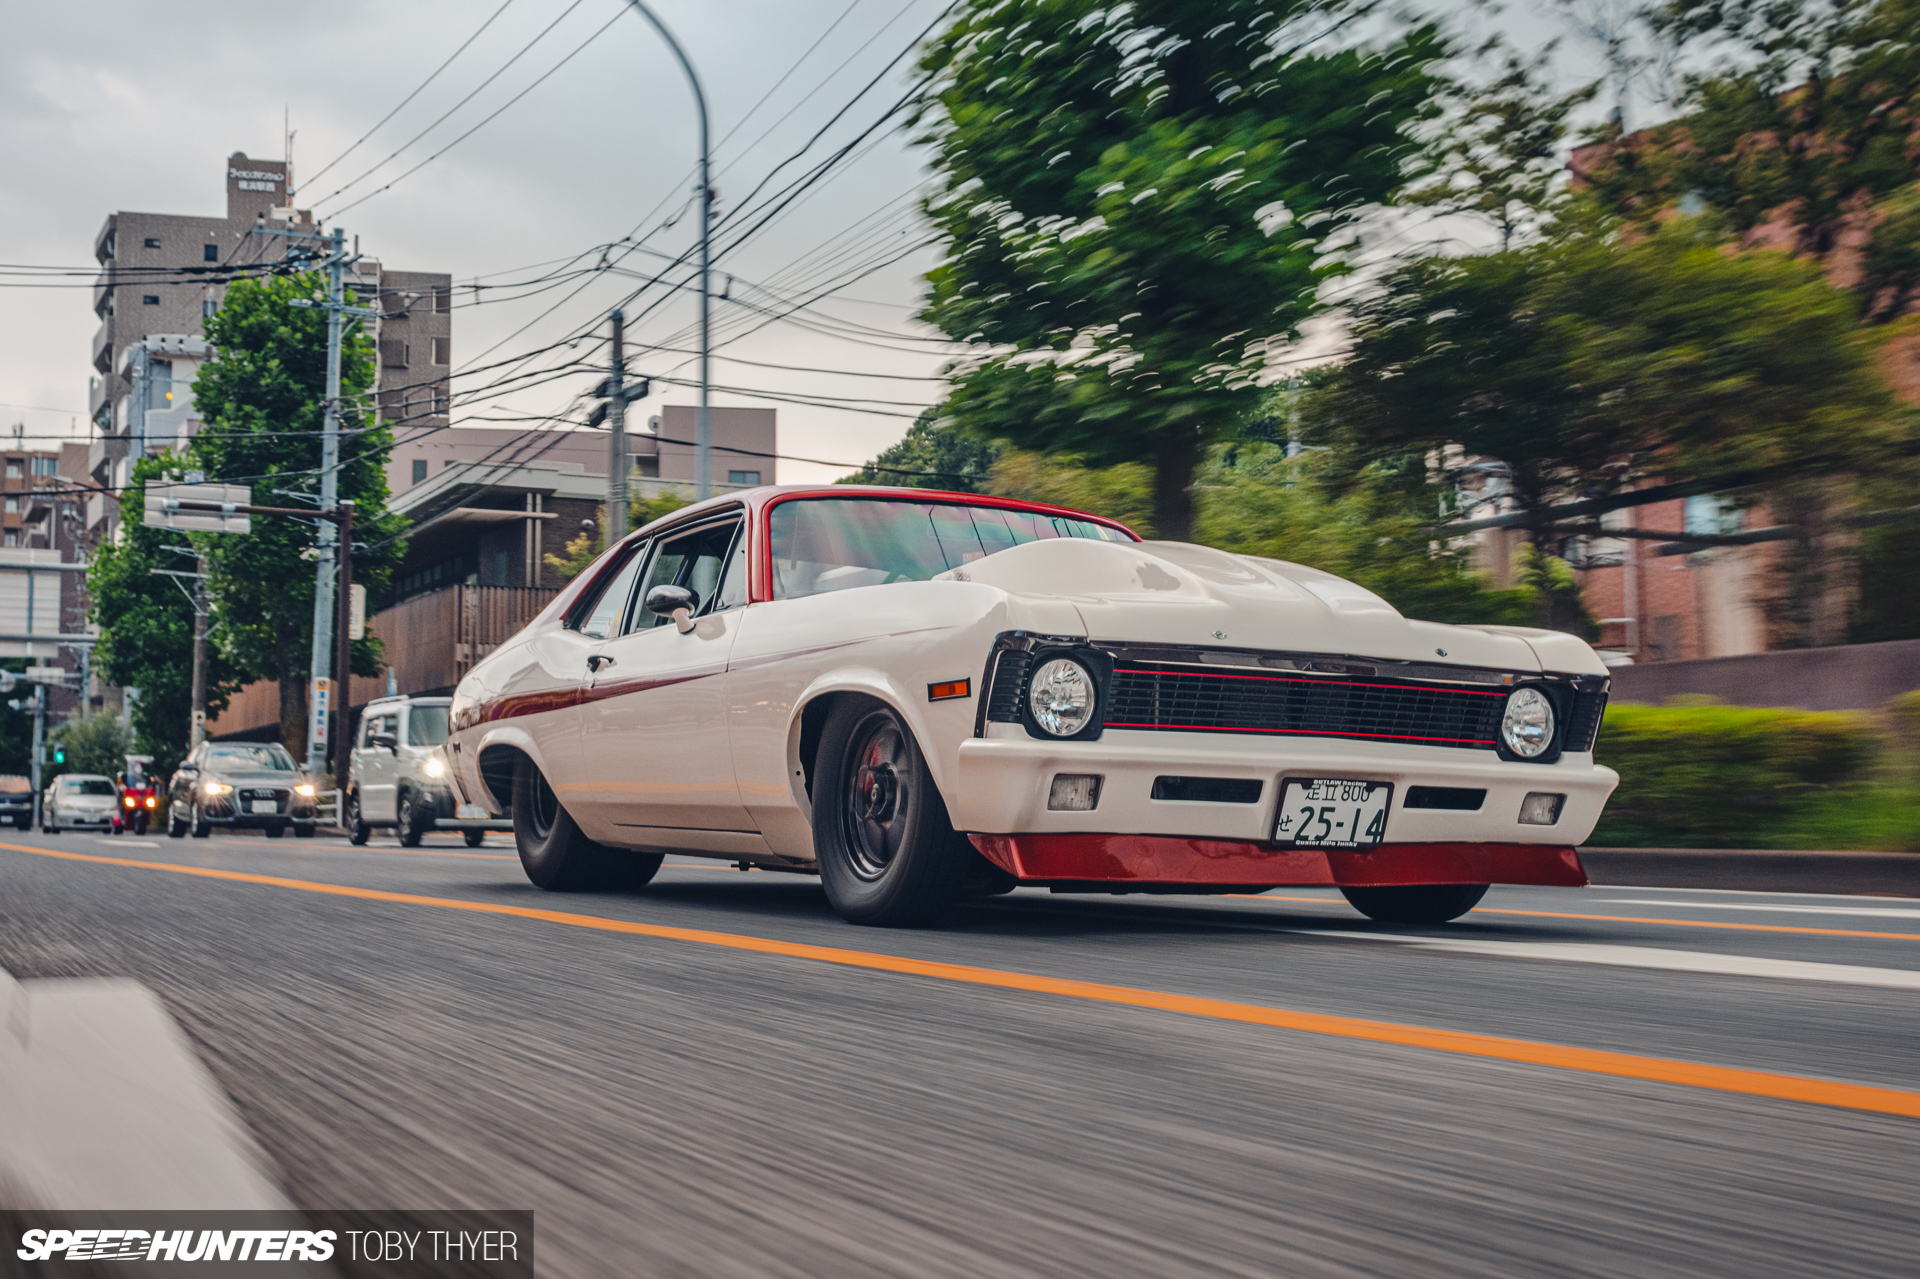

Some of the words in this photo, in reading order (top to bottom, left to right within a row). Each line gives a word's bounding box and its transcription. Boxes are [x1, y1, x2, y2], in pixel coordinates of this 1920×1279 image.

[1341, 785, 1371, 802] 800
[1279, 815, 1293, 832] せ
[1294, 806, 1384, 844] 25-14
